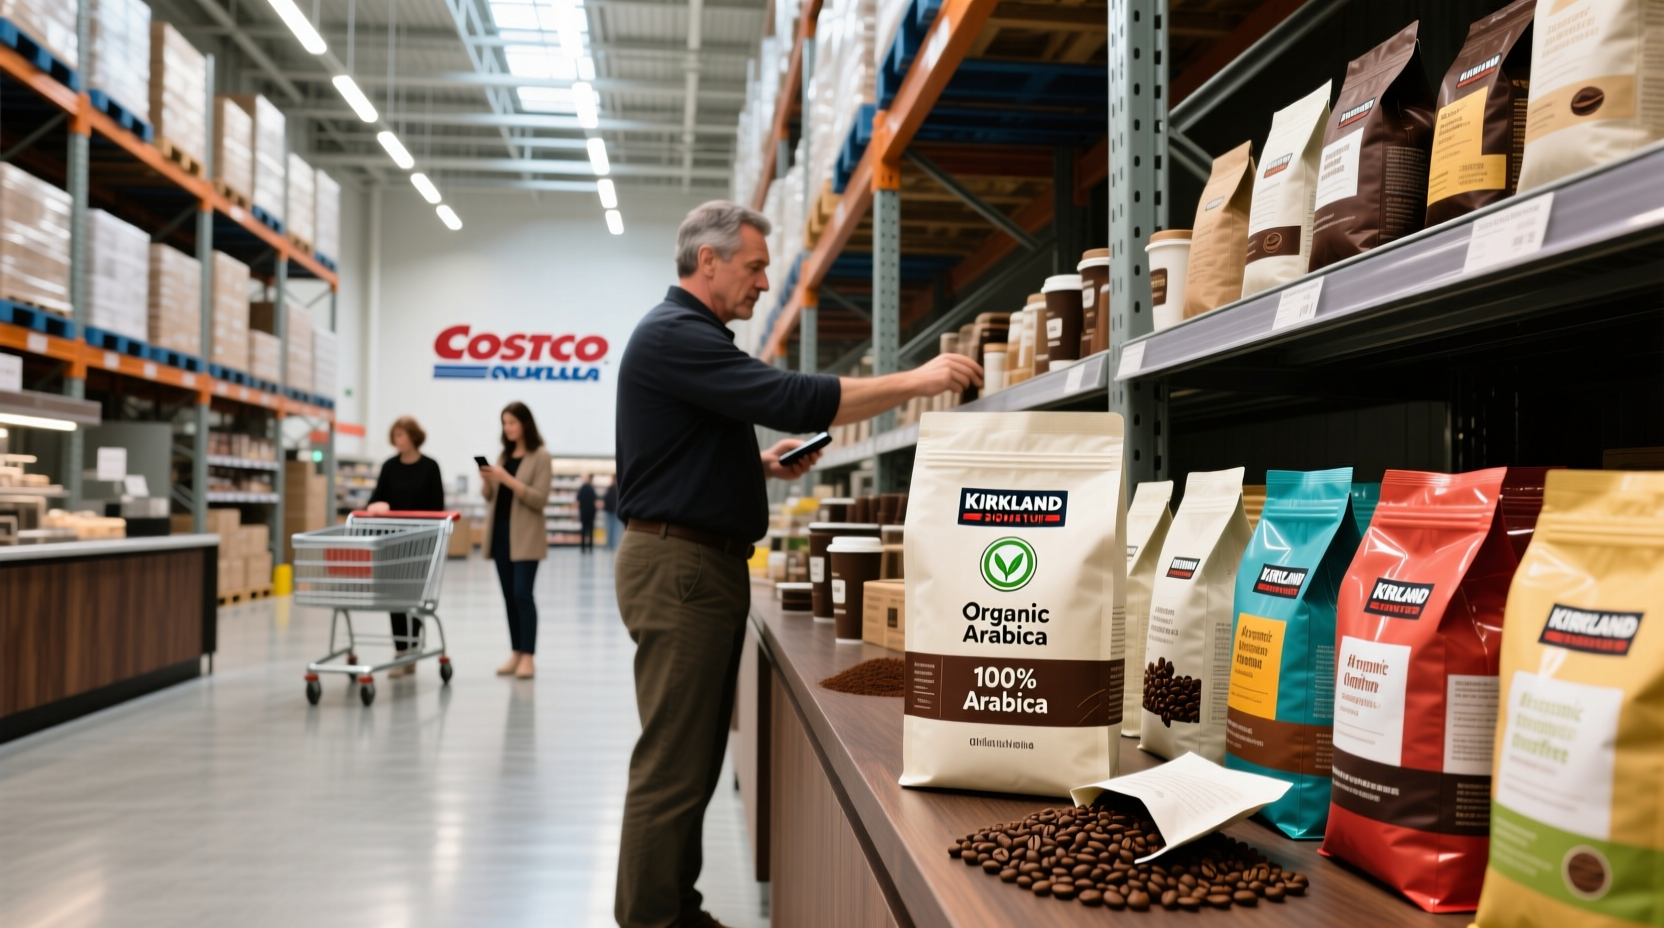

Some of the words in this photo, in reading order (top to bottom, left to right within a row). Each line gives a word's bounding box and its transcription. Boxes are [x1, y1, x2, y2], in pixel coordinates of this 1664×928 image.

[434, 325, 608, 362] COSTCO
[965, 493, 1062, 511] KIRKLAND
[962, 602, 1050, 626] Organic
[963, 625, 1047, 645] Arabica
[974, 666, 1037, 689] 100%
[963, 691, 1048, 714] Arabica
